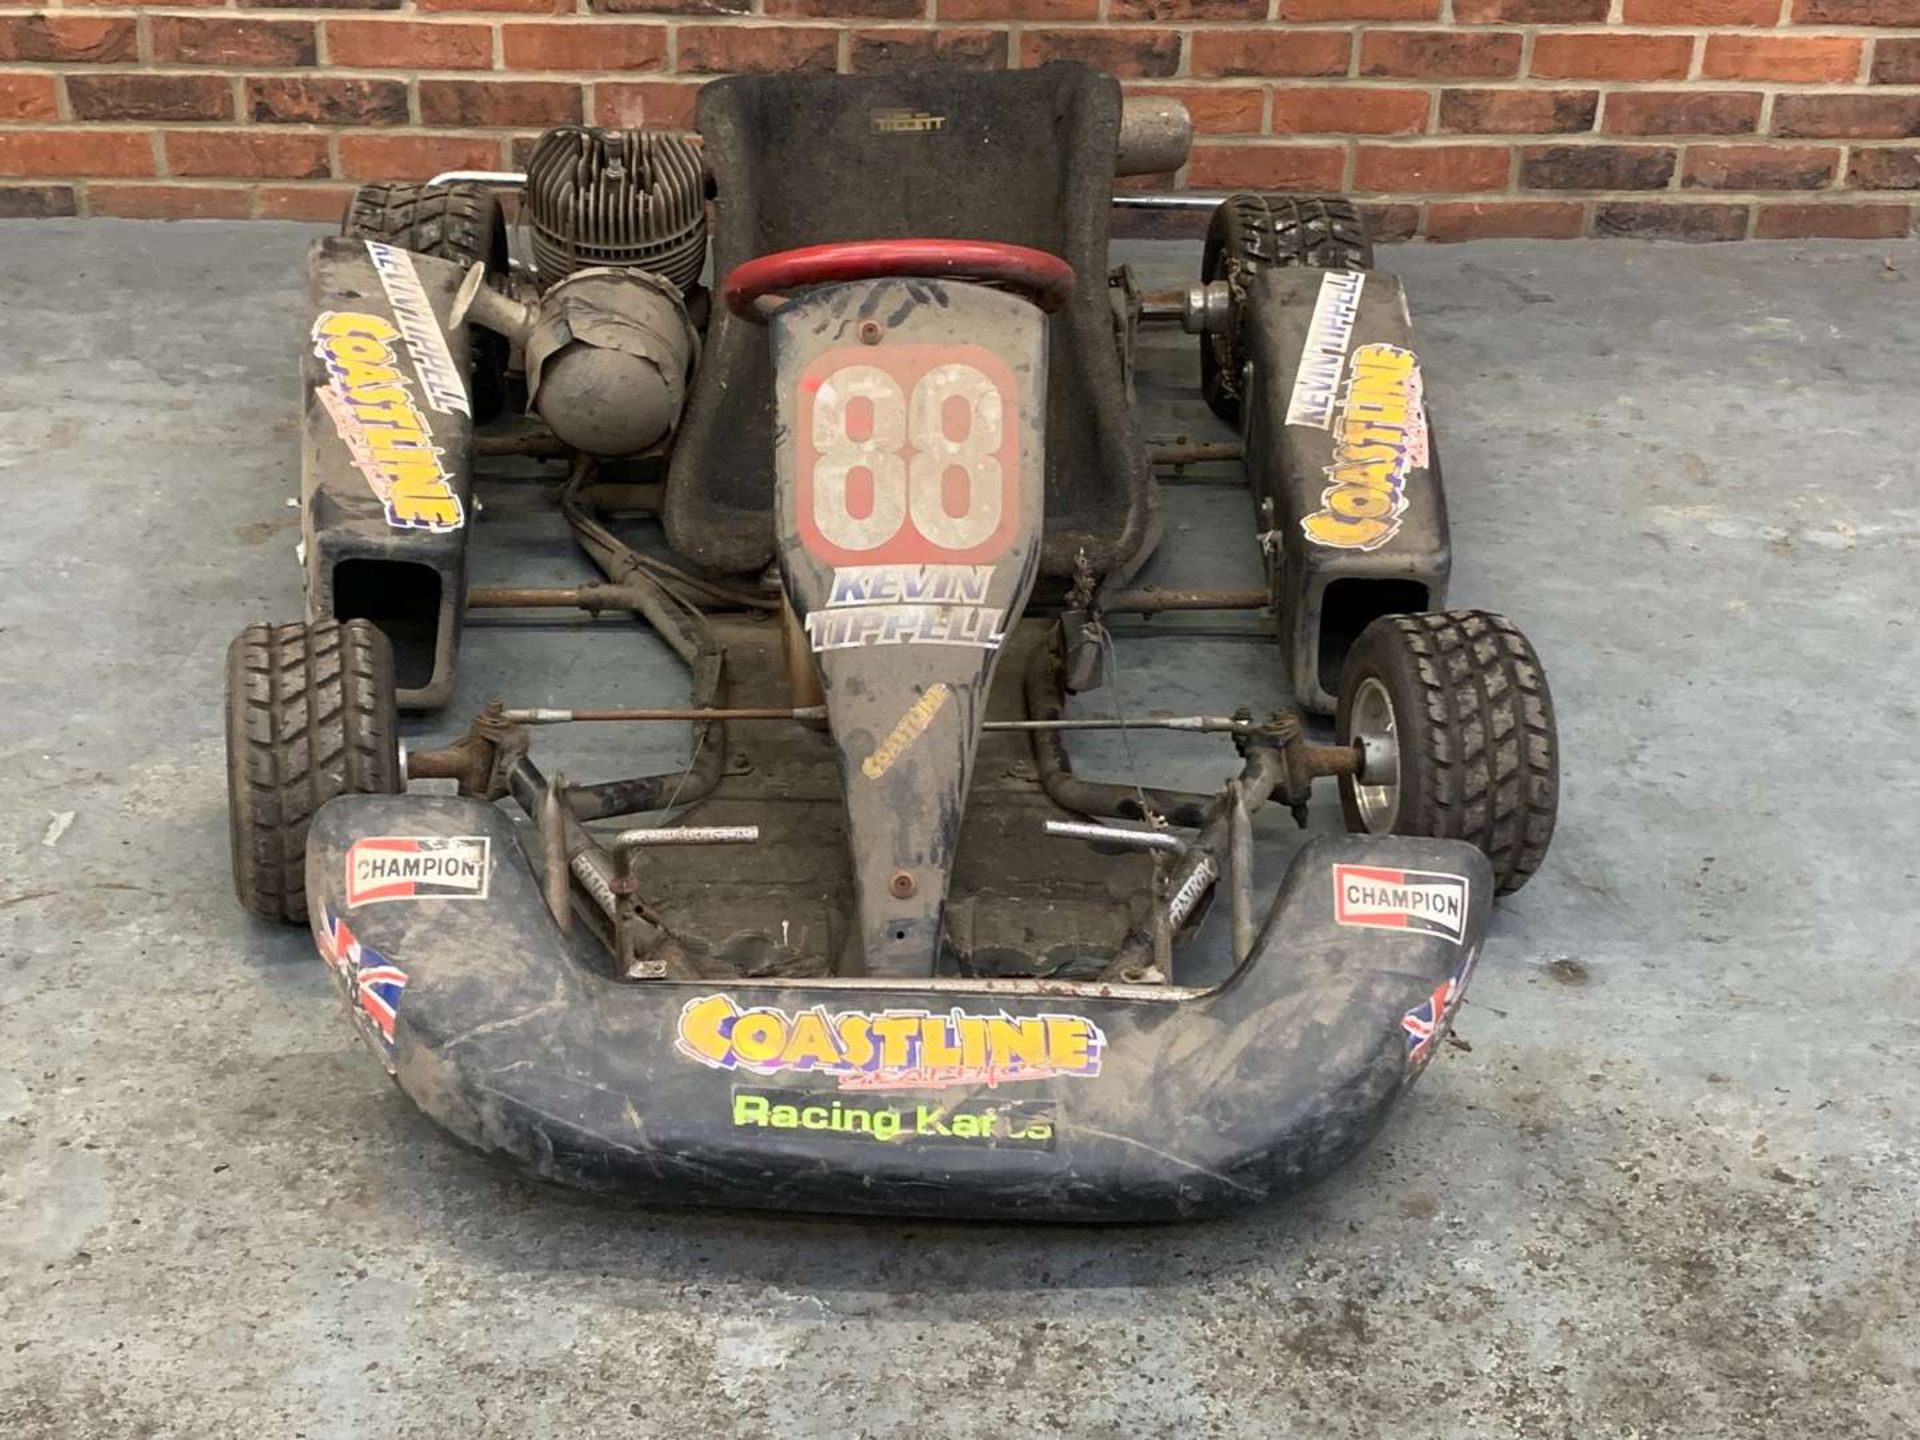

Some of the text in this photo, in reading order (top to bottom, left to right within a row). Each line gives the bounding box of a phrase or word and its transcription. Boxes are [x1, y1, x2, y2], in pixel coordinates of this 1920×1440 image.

[1288, 272, 1364, 427] KEVIN TIPPELL
[313, 312, 463, 531] COASTLINE
[1302, 344, 1420, 550] COASTLINE
[812, 364, 1002, 551] 88
[828, 566, 994, 605] KEVIN
[807, 606, 1004, 651] TIPPELL
[357, 856, 478, 881] CHAMPION
[1346, 885, 1459, 918] CHAMPION
[676, 994, 1105, 1078] COASTLINE
[733, 1094, 899, 1141] Racing
